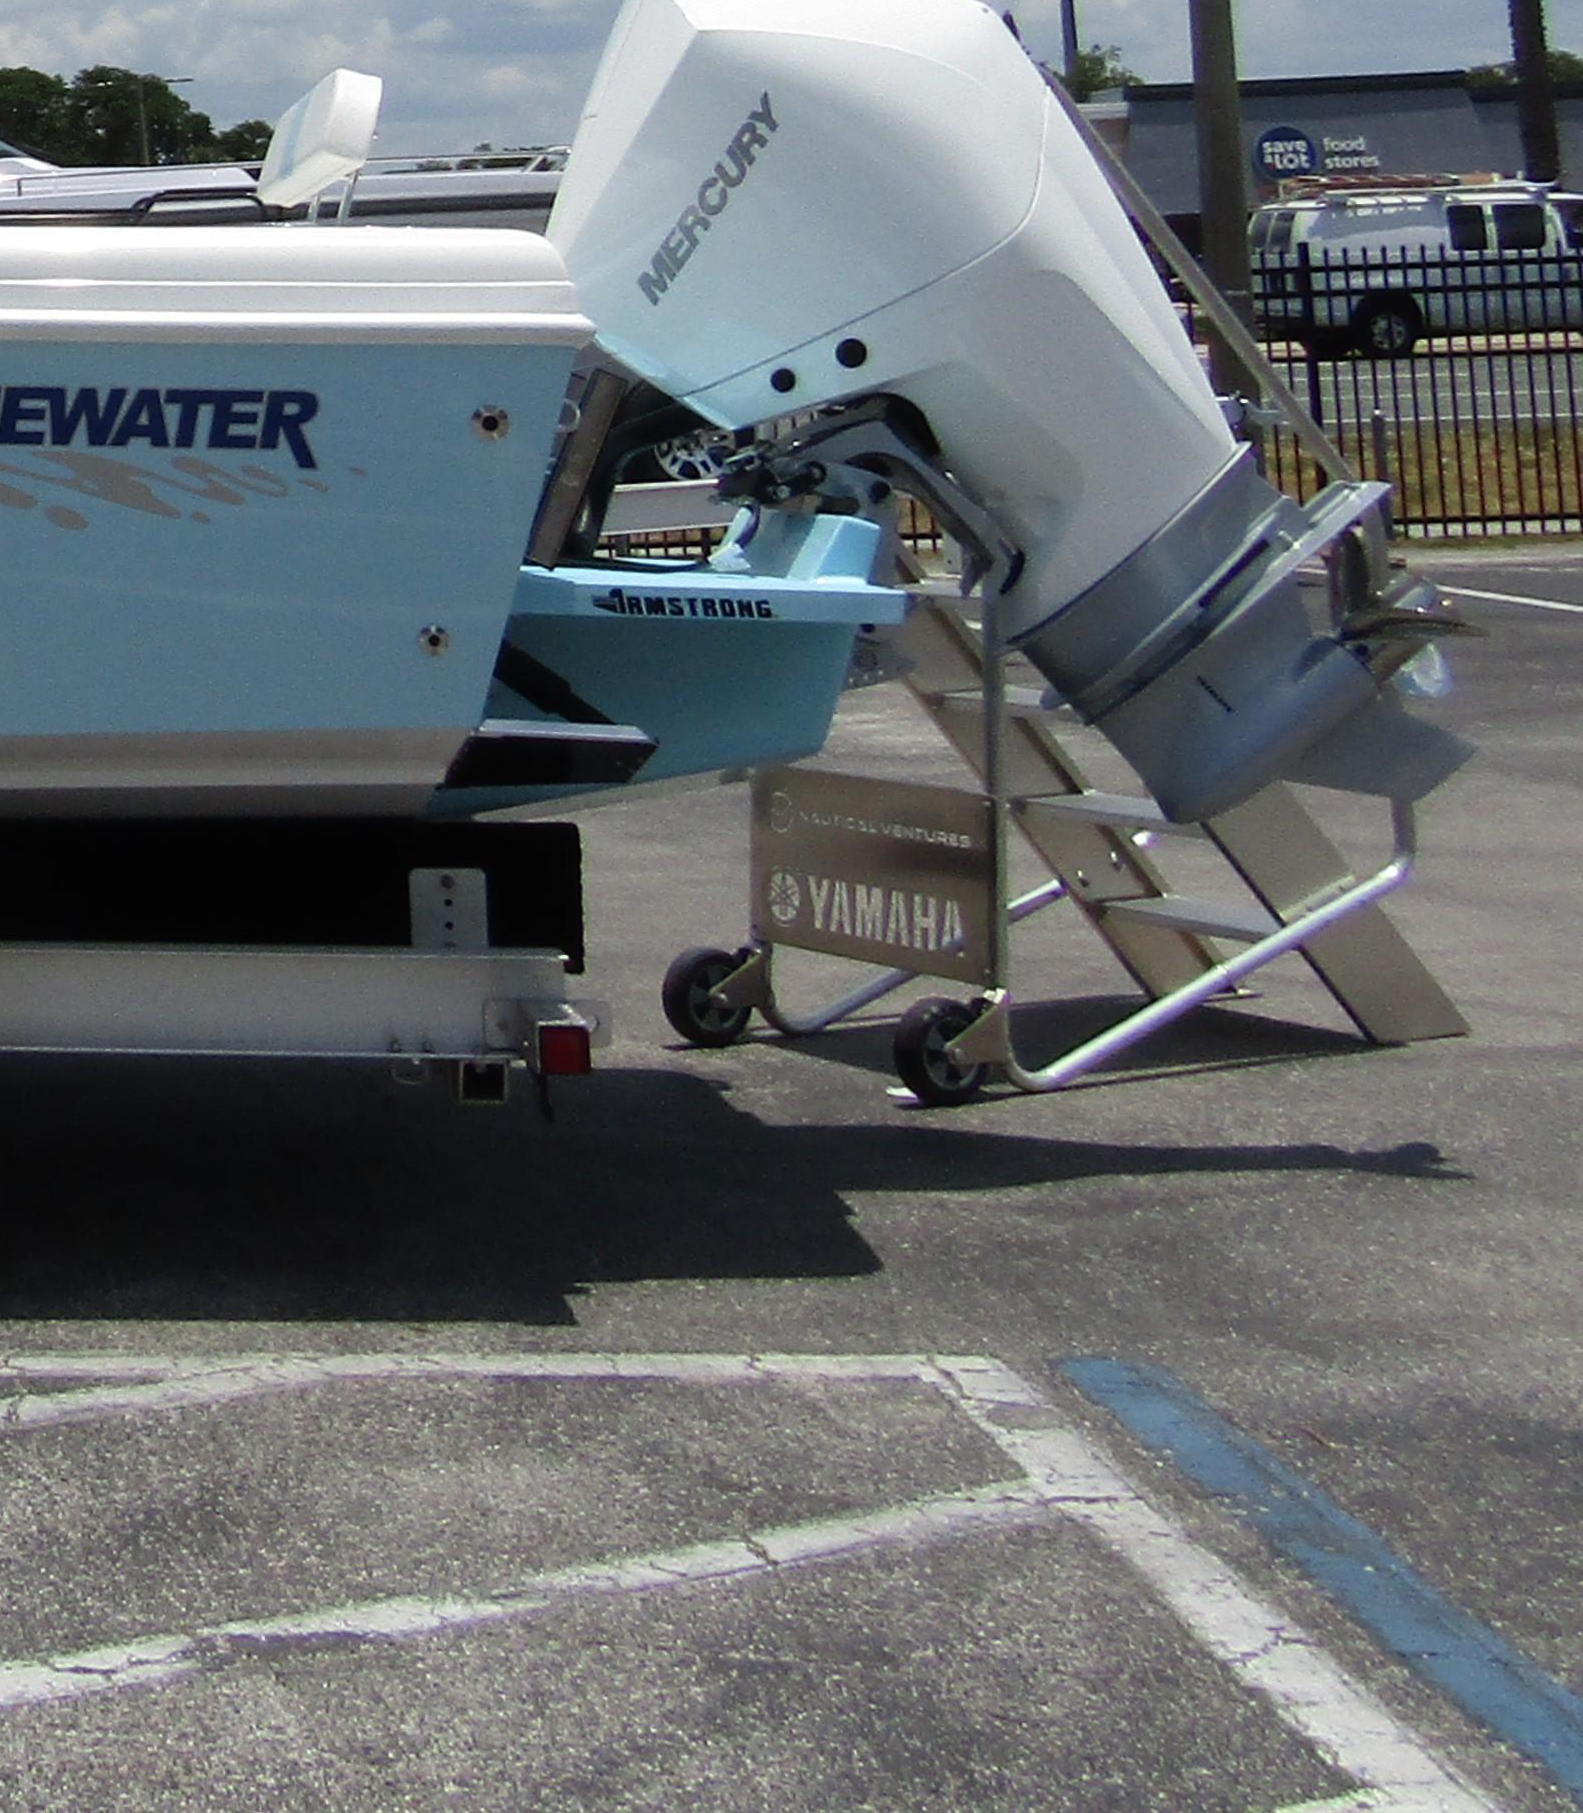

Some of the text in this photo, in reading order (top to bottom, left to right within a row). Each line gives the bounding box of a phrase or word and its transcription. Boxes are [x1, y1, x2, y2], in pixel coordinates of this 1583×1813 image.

[1261, 139, 1308, 154] save
[1322, 135, 1366, 152] food
[1324, 155, 1381, 169] stores
[636, 90, 780, 306] MERCURY
[591, 587, 773, 619] ARMSTRONG
[880, 823, 973, 849] VENTURES
[807, 874, 966, 958] YAMAHA
